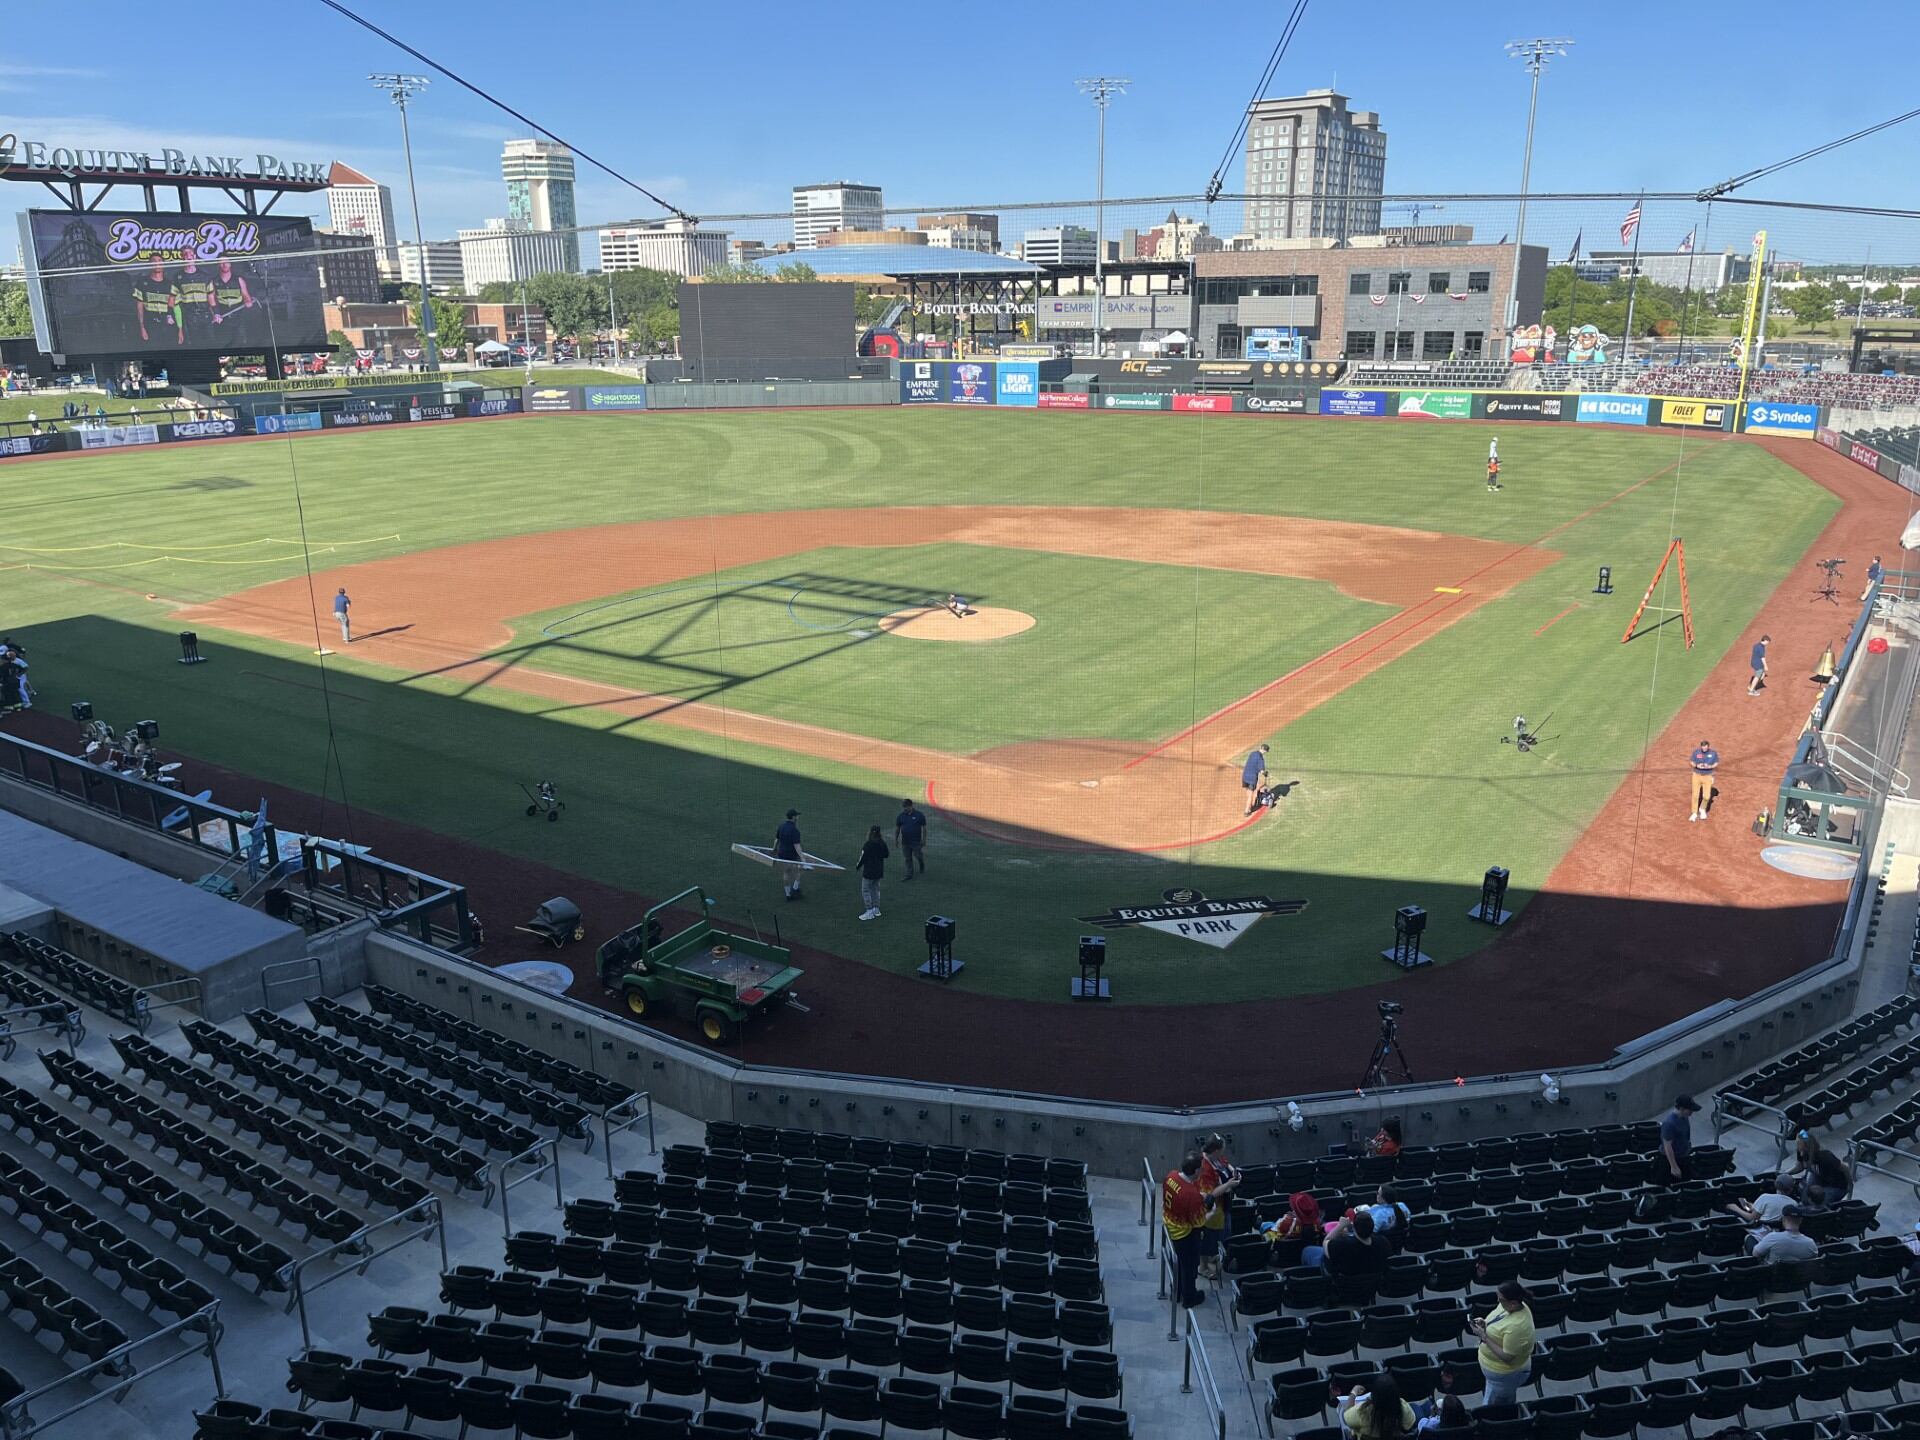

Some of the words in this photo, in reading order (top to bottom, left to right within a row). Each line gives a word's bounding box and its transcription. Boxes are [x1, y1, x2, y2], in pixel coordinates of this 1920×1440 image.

[23, 141, 149, 178] EQUITY
[161, 148, 246, 180] BANK
[256, 154, 329, 184] PARK
[107, 220, 198, 261] Banana
[197, 222, 258, 261] Ball
[924, 302, 965, 317] EQUITY
[970, 302, 1001, 314] BANK
[1005, 302, 1036, 314] PARK
[1064, 303, 1105, 313] EMPRIE
[1107, 303, 1137, 313] BANK
[1120, 360, 1149, 373] ACT
[906, 380, 939, 388] EMPRISE
[1006, 374, 1029, 384] BUD
[912, 388, 935, 397] BANK
[1002, 383, 1033, 393] LIGHT
[488, 400, 508, 411] IWP
[1115, 398, 1144, 406] Commerce
[1145, 398, 1160, 406] Bank
[1262, 400, 1303, 408] LEXUS
[1498, 403, 1521, 411] EQUITY
[1522, 403, 1541, 411] BANK
[1598, 401, 1643, 416] KOCH
[1672, 405, 1696, 416] FOLEY
[1705, 408, 1723, 421] CAT
[1769, 409, 1812, 424] Syndeo
[1118, 905, 1200, 920] EQUITY
[1207, 899, 1269, 913] BANK
[1177, 919, 1238, 936] PARK
